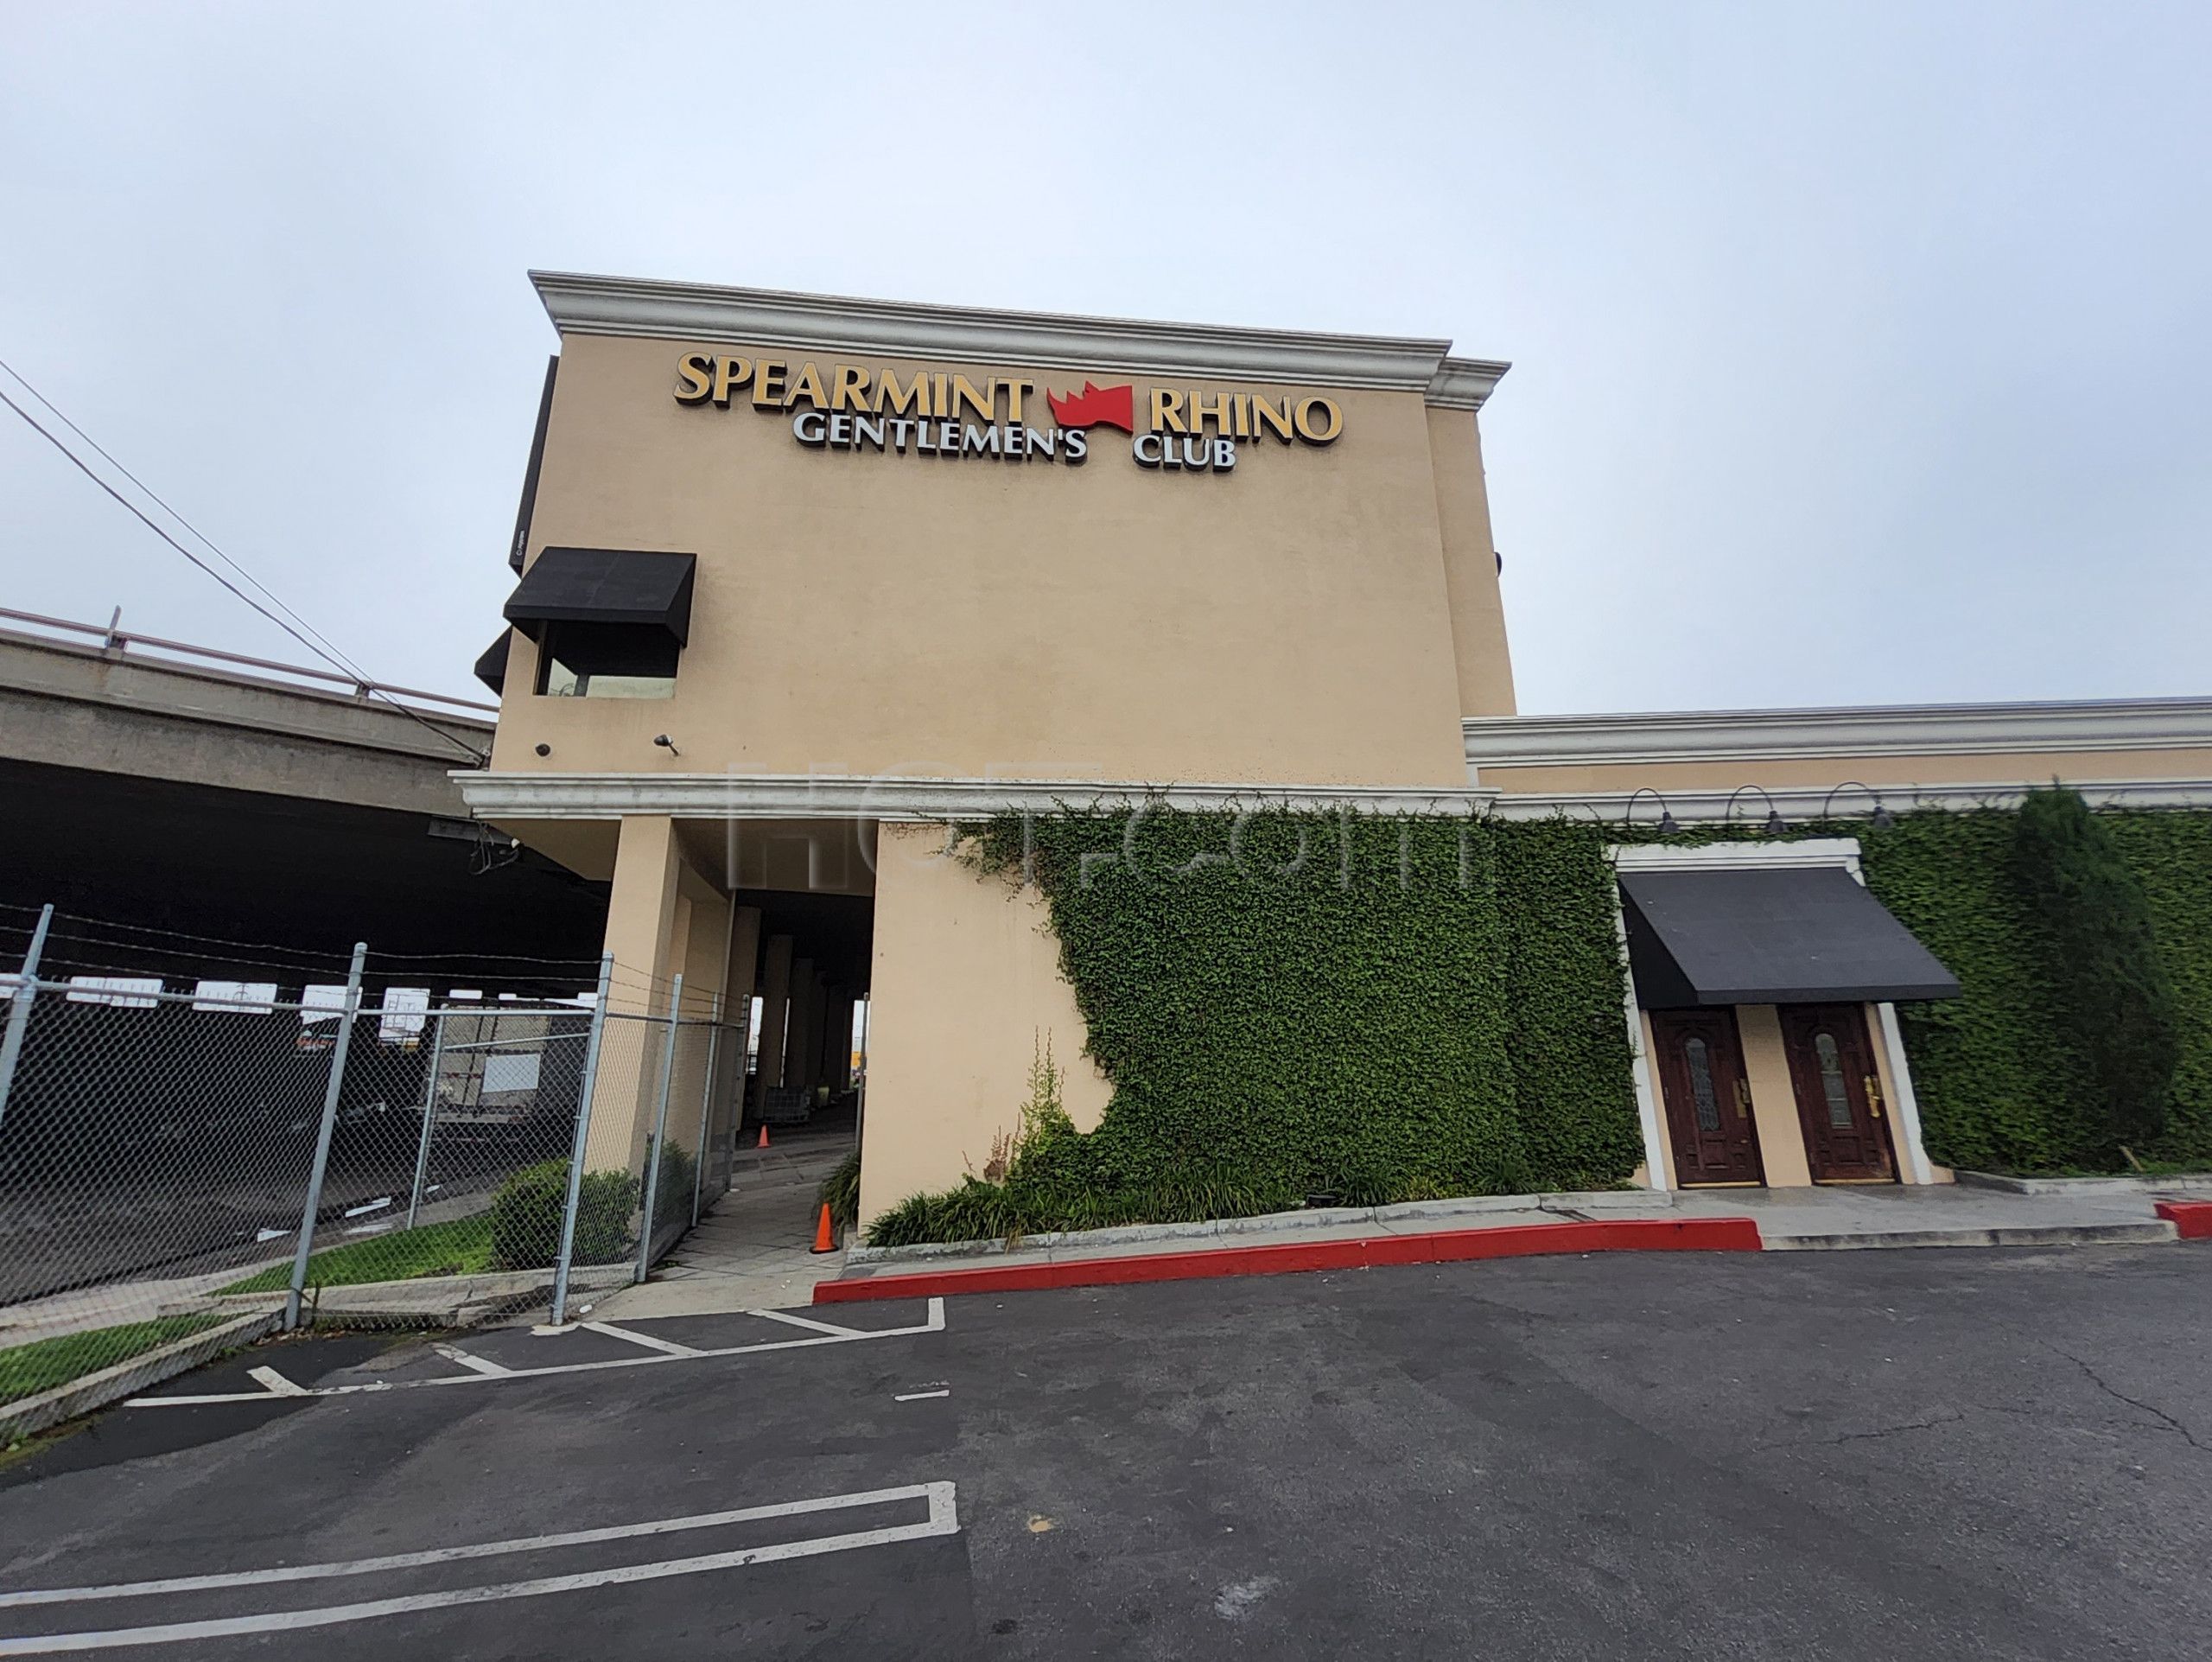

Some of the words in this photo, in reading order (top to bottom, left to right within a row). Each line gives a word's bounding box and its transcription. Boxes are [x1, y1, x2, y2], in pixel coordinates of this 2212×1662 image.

[673, 352, 1035, 423] SPEARMINT
[1148, 387, 1344, 443] RHINO
[791, 411, 1087, 459] GENTLEMEN'S
[1132, 435, 1236, 468] CLUB
